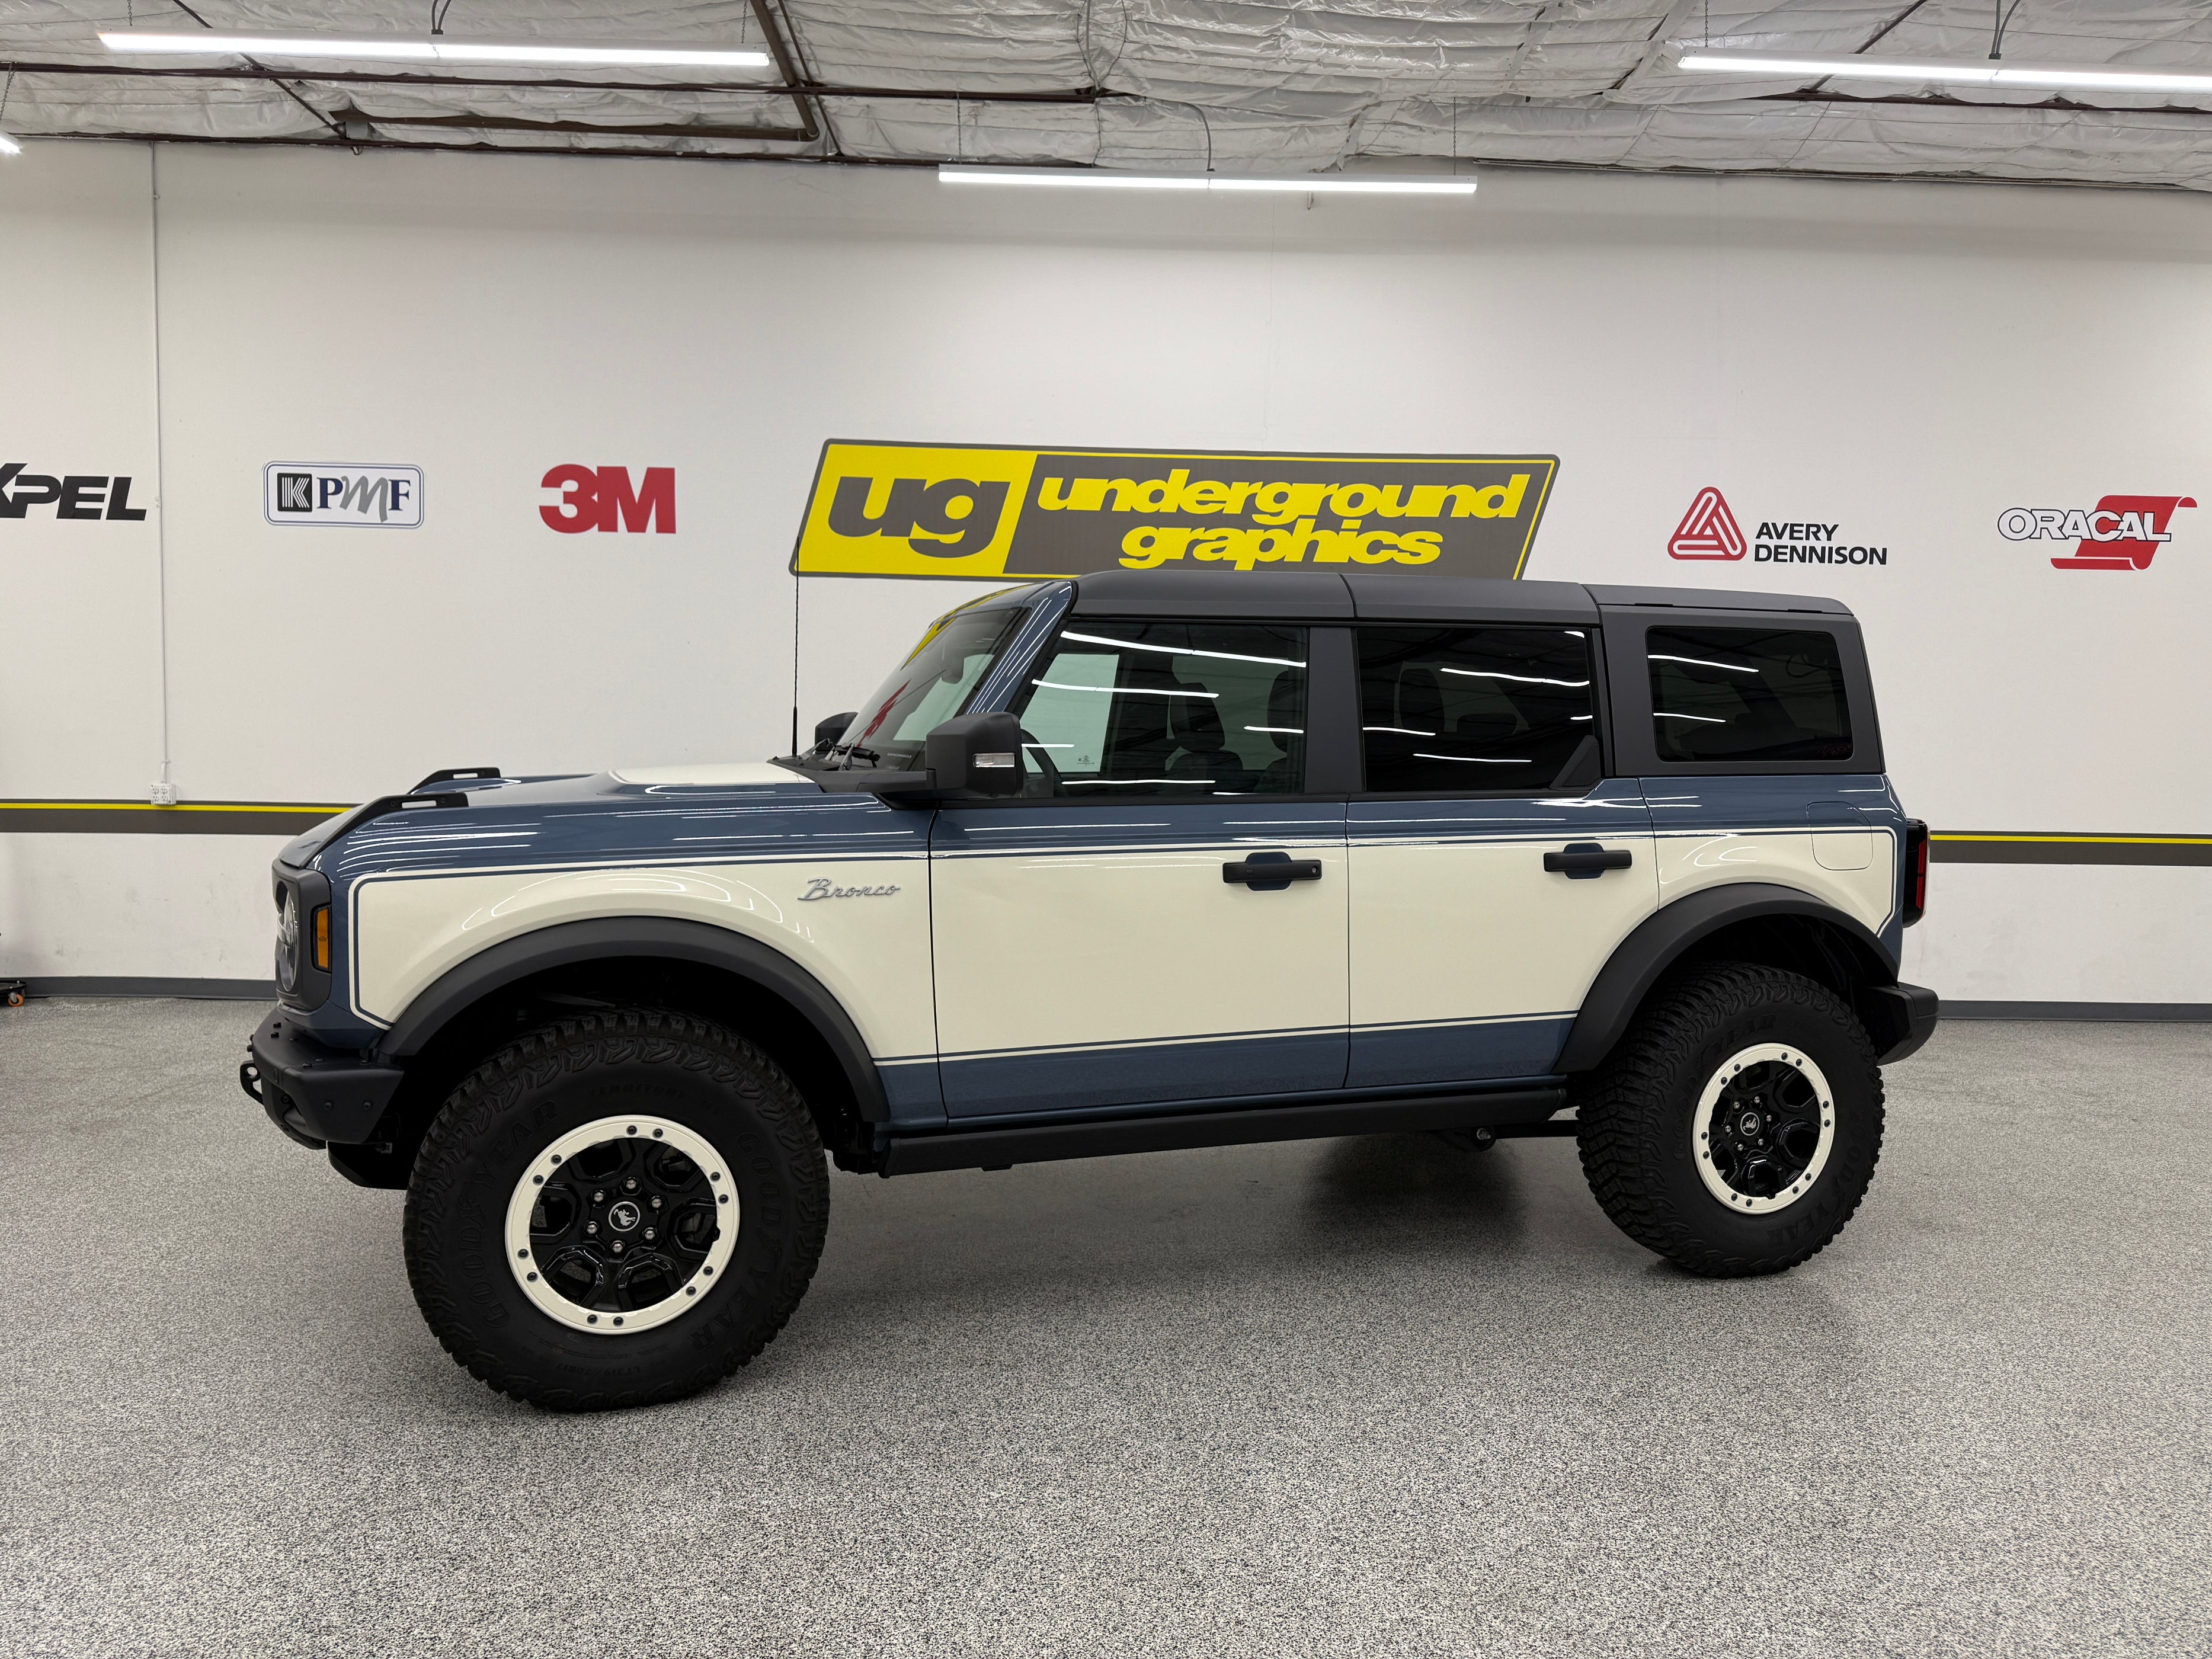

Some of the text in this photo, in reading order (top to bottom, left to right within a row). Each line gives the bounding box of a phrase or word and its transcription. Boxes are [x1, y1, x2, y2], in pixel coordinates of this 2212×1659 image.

[539, 464, 676, 534] 3M
[828, 476, 1011, 558] ug
[1038, 469, 1531, 525] underground
[1119, 518, 1443, 570] graphics
[1755, 522, 1839, 542] AVERY
[1997, 507, 2172, 542] ORACAL
[1755, 544, 1887, 565] DENNISON
[797, 877, 901, 901] Bronco
